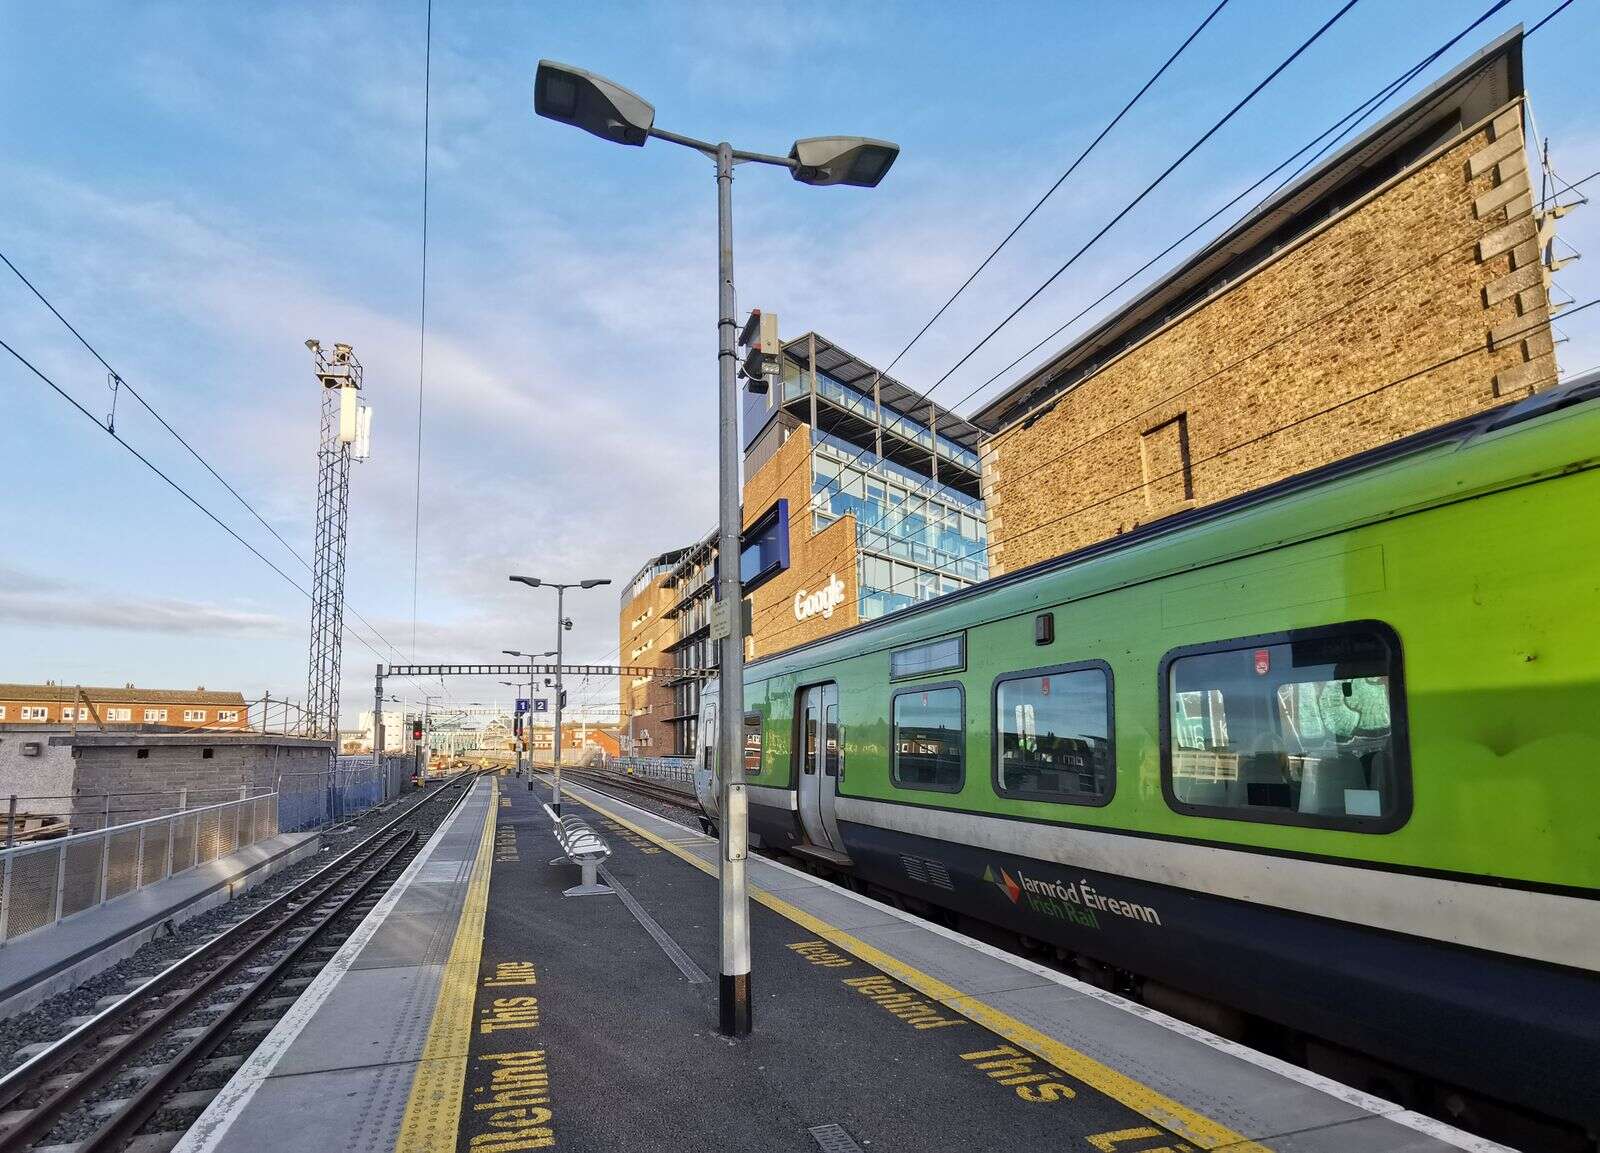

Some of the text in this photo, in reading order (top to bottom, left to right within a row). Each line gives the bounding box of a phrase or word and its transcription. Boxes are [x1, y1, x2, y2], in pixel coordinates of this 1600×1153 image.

[794, 573, 845, 621] Google
[1018, 870, 1162, 926] Iarnród Éireann
[1026, 893, 1101, 930] Irish Rail
[484, 961, 537, 987] Line
[480, 996, 540, 1034] This
[959, 1044, 1077, 1103] This
